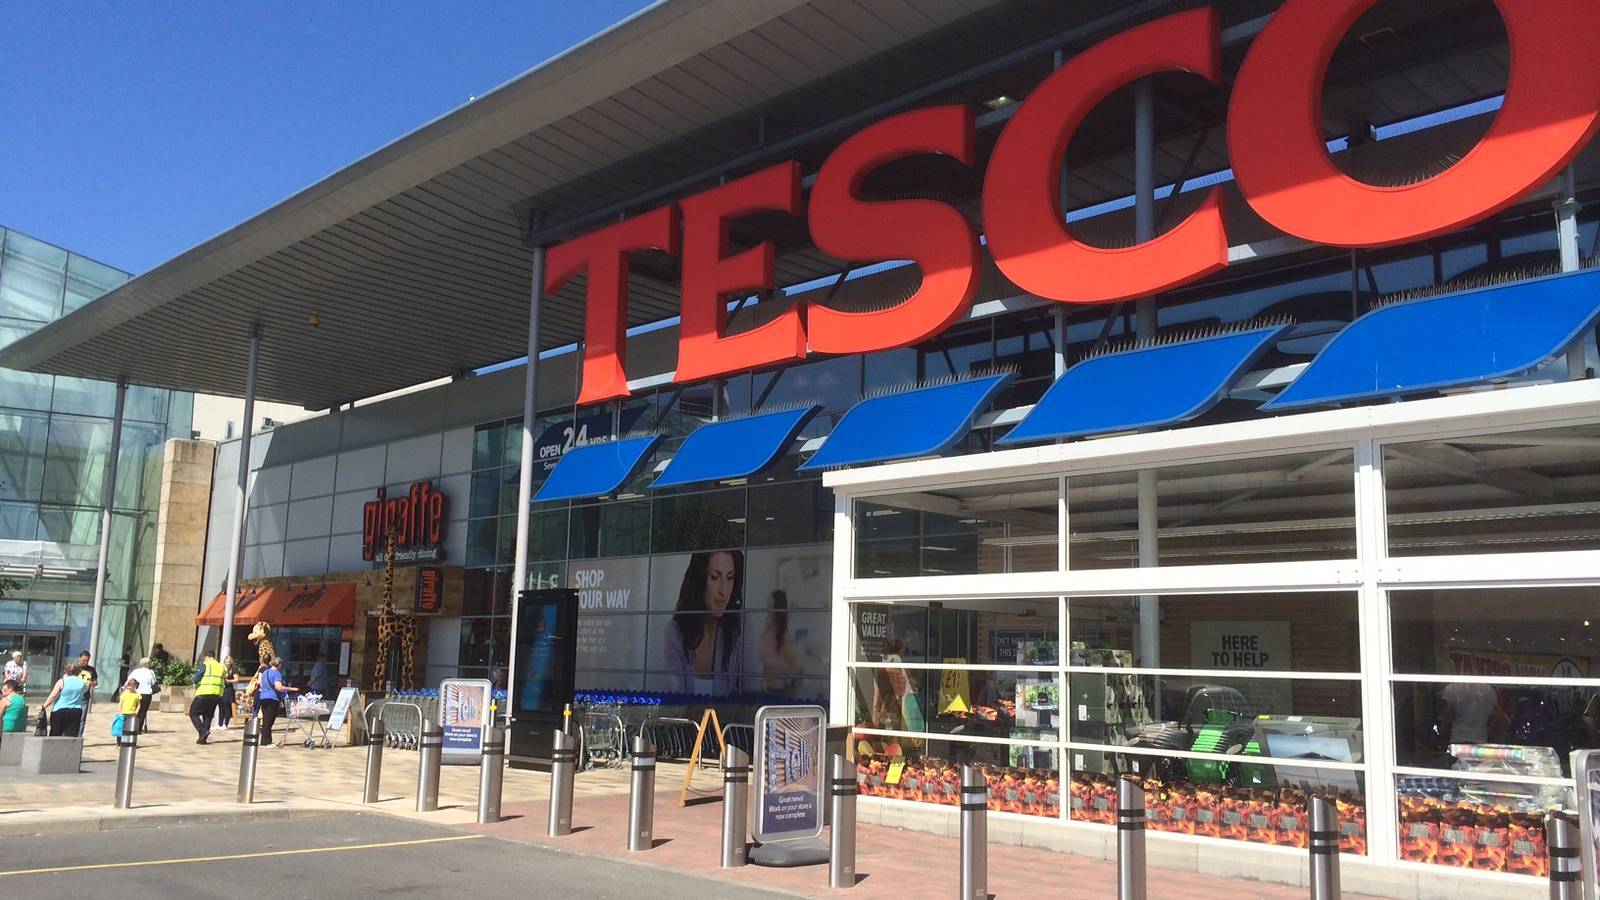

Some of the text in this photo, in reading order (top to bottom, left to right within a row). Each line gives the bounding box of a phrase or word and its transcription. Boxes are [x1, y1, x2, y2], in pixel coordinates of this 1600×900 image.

[545, 0, 1600, 405] TESCO
[540, 444, 561, 458] OPEN
[562, 424, 588, 454] 24
[363, 480, 444, 561] giraffe
[418, 548, 437, 558] dining
[576, 569, 605, 589] SHOP
[578, 588, 630, 609] OUR WAY
[861, 611, 887, 625] GREAT
[861, 624, 888, 638] VALUE
[1221, 634, 1259, 651] HERE
[1211, 651, 1269, 667] TO HELP
[778, 796, 791, 804] Great
[768, 805, 781, 813] Work
[786, 804, 798, 813] your
[785, 812, 806, 820] complete
